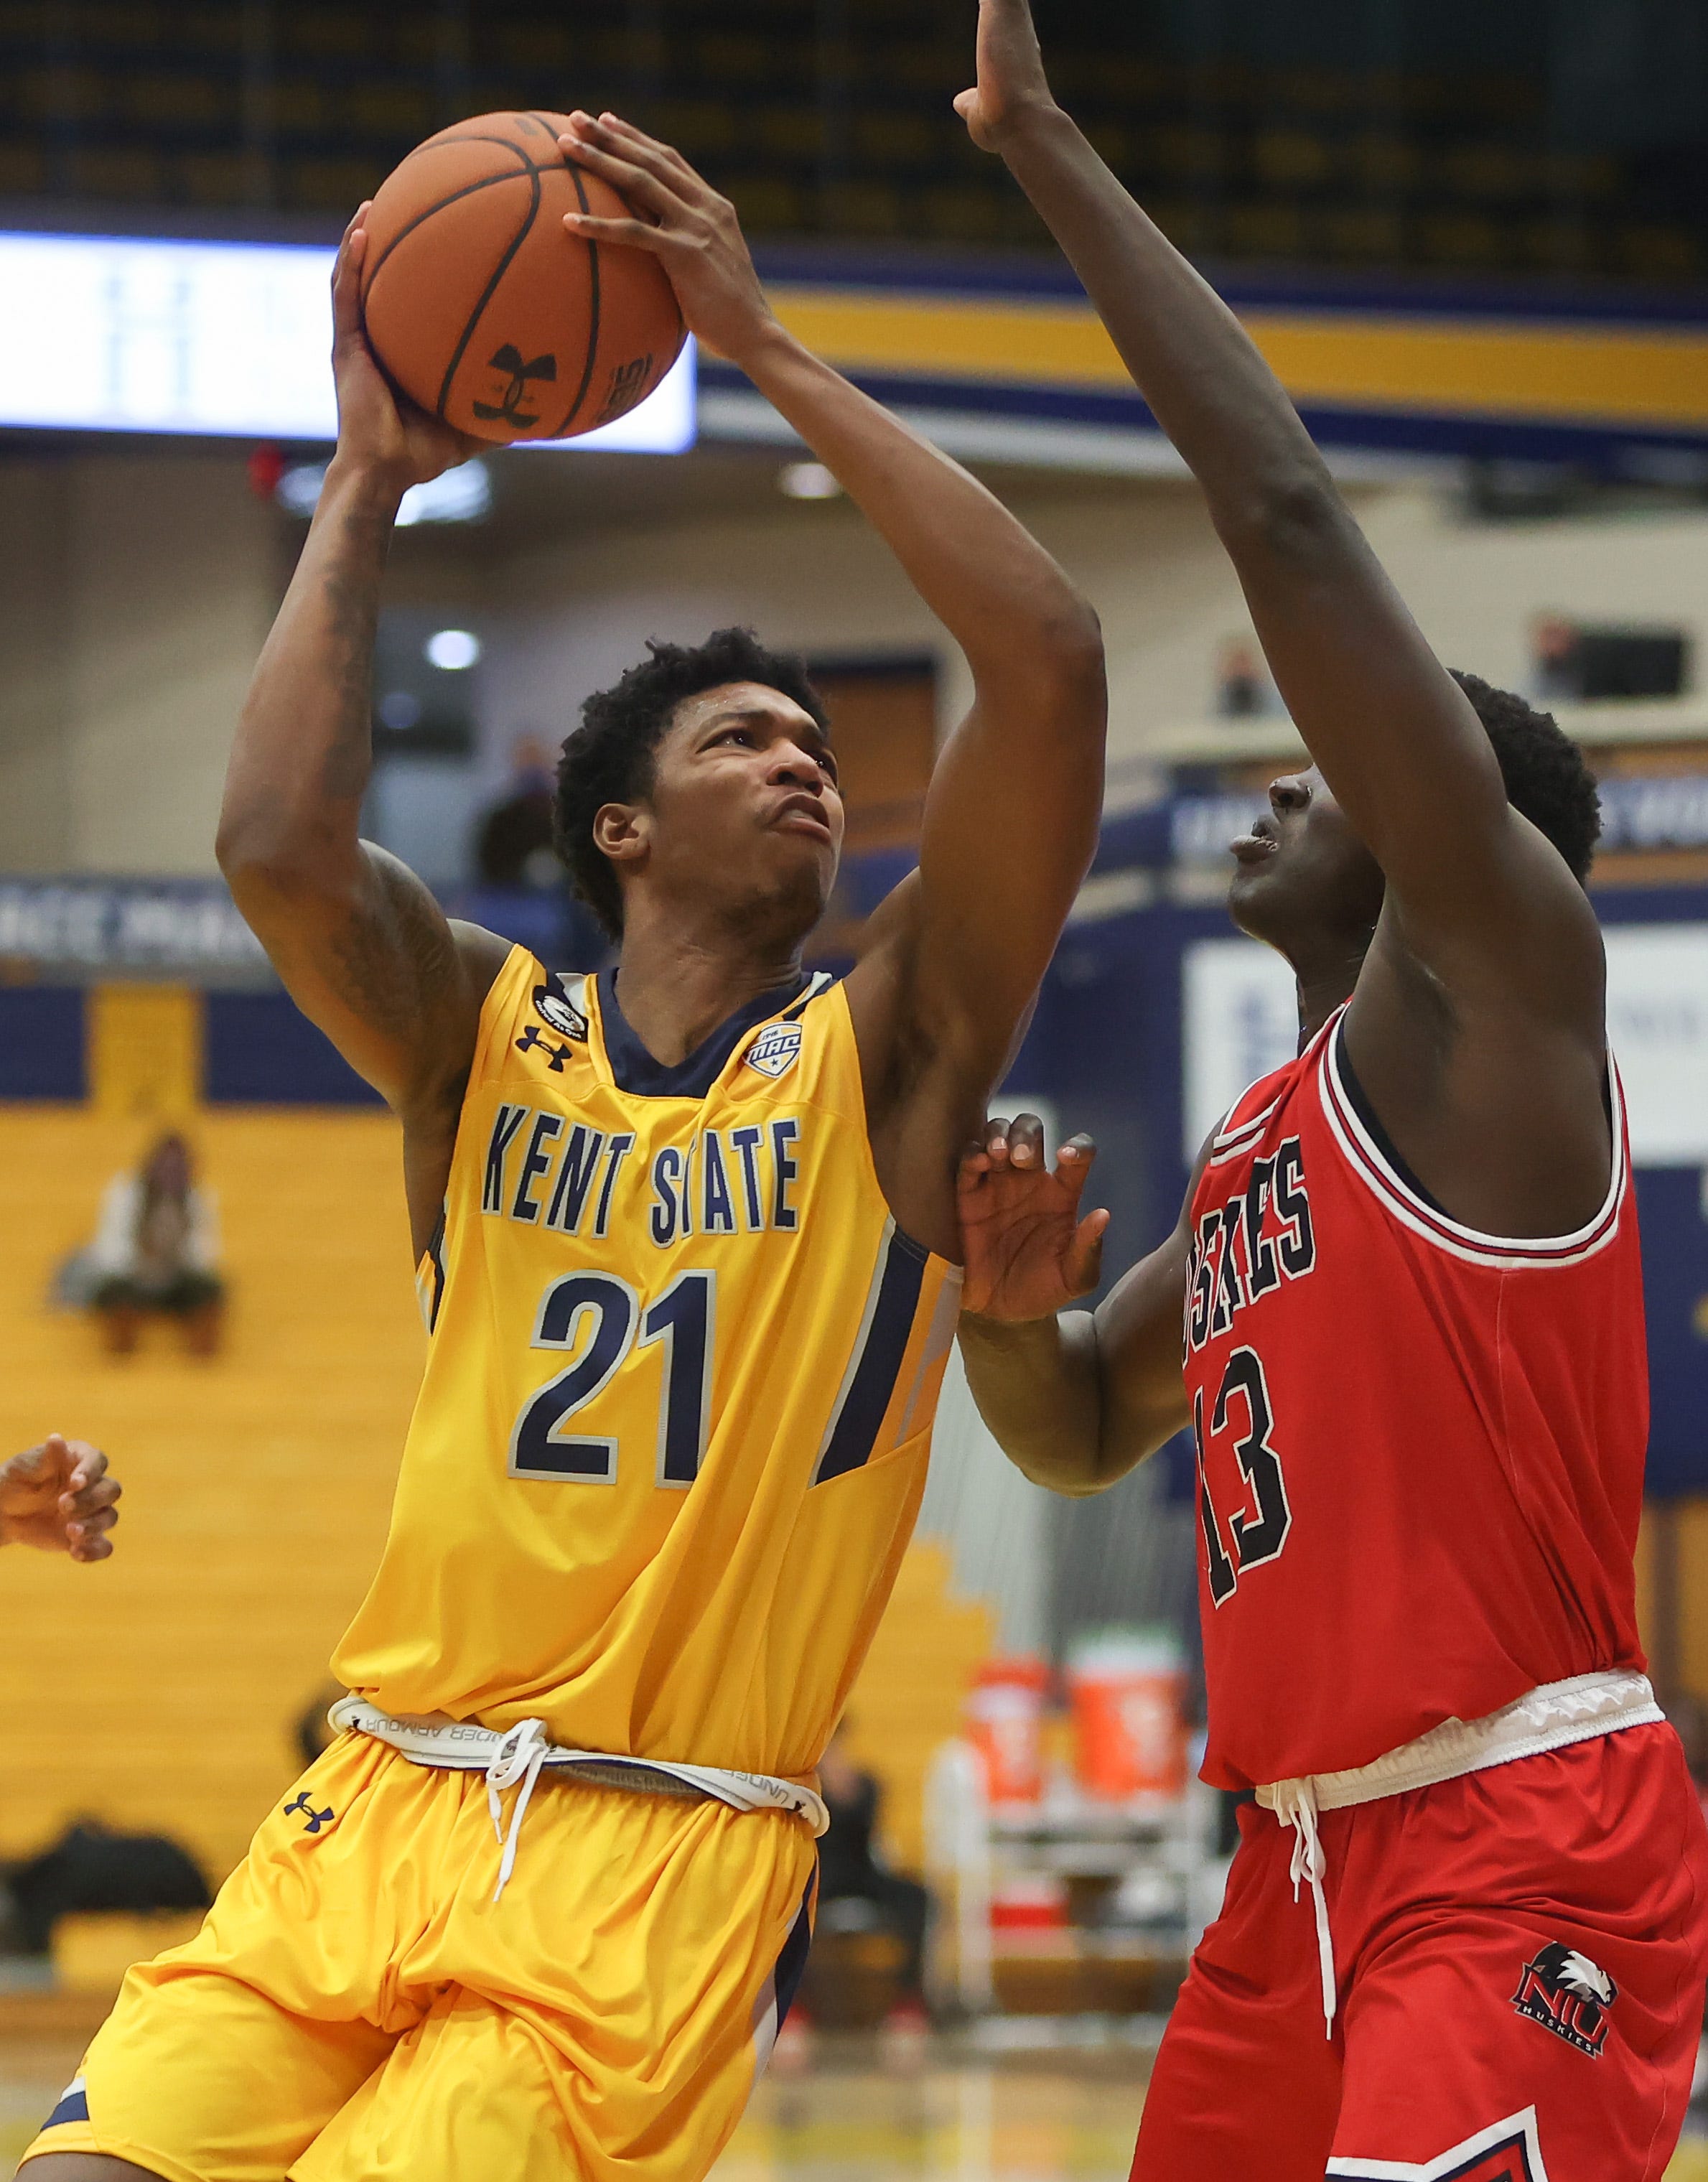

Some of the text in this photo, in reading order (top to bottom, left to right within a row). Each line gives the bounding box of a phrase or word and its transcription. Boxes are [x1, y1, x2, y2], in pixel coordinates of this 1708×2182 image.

[750, 1035, 801, 1061] MAC
[480, 1102, 637, 1240] KENT
[507, 1268, 717, 1490] 21
[1194, 1344, 1292, 1610] 13
[365, 1719, 504, 1743] NDER ARMOUR
[1520, 1970, 1607, 2044] NIU
[1523, 2005, 1592, 2053] HUSKIES
